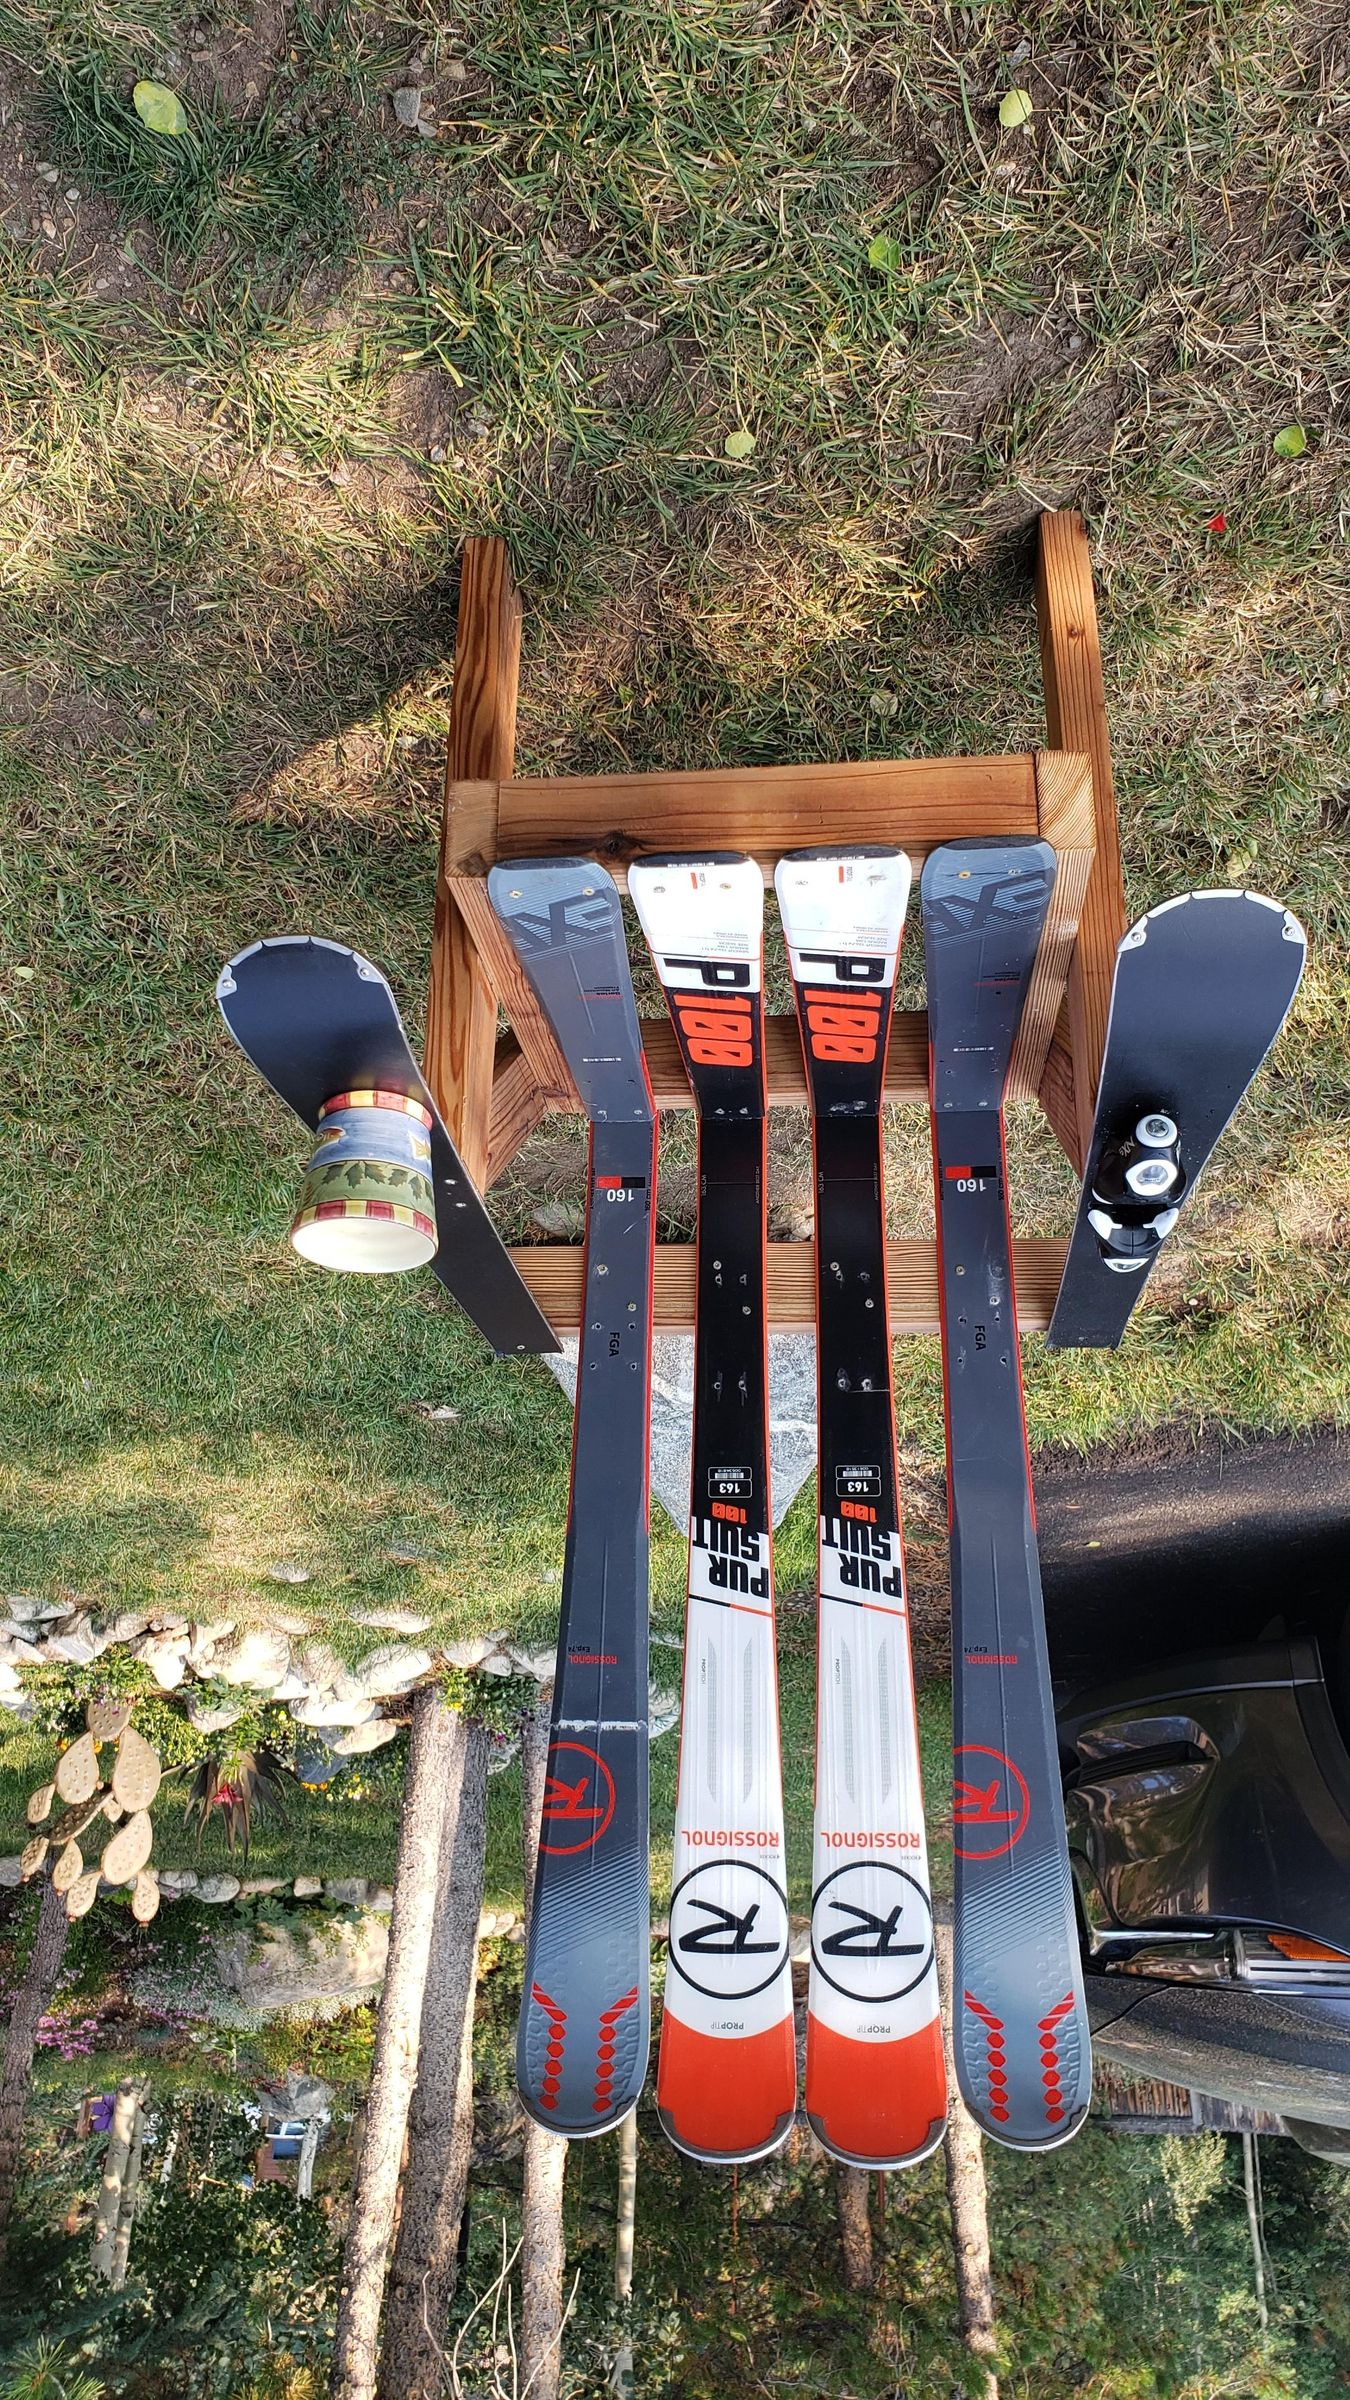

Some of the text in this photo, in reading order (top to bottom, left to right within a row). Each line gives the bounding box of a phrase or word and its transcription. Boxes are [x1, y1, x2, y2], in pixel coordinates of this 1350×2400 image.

[956, 1179, 986, 1192] 160
[606, 1189, 634, 1202] 160
[609, 1332, 620, 1357] FGA
[974, 1326, 986, 1350] FGA
[719, 1483, 740, 1493] 163
[848, 1481, 869, 1492] 163
[712, 1502, 748, 1524] 100
[841, 1501, 877, 1523] 100
[692, 1516, 760, 1562] SUIT
[822, 1516, 891, 1561] SUIT
[707, 1553, 769, 1600] PUR
[838, 1552, 902, 1599] PUR
[568, 1655, 617, 1664] ROSSIGNOL
[965, 1655, 1017, 1664] ROSSIGNOL
[681, 1831, 779, 1847] ROSSIGNOL
[820, 1832, 920, 1848] ROSSIGNOL
[678, 1899, 780, 1954] R
[821, 1901, 924, 1957] R
[711, 2022, 744, 2030] PROPTIP
[856, 2025, 890, 2033] PROPTIP
